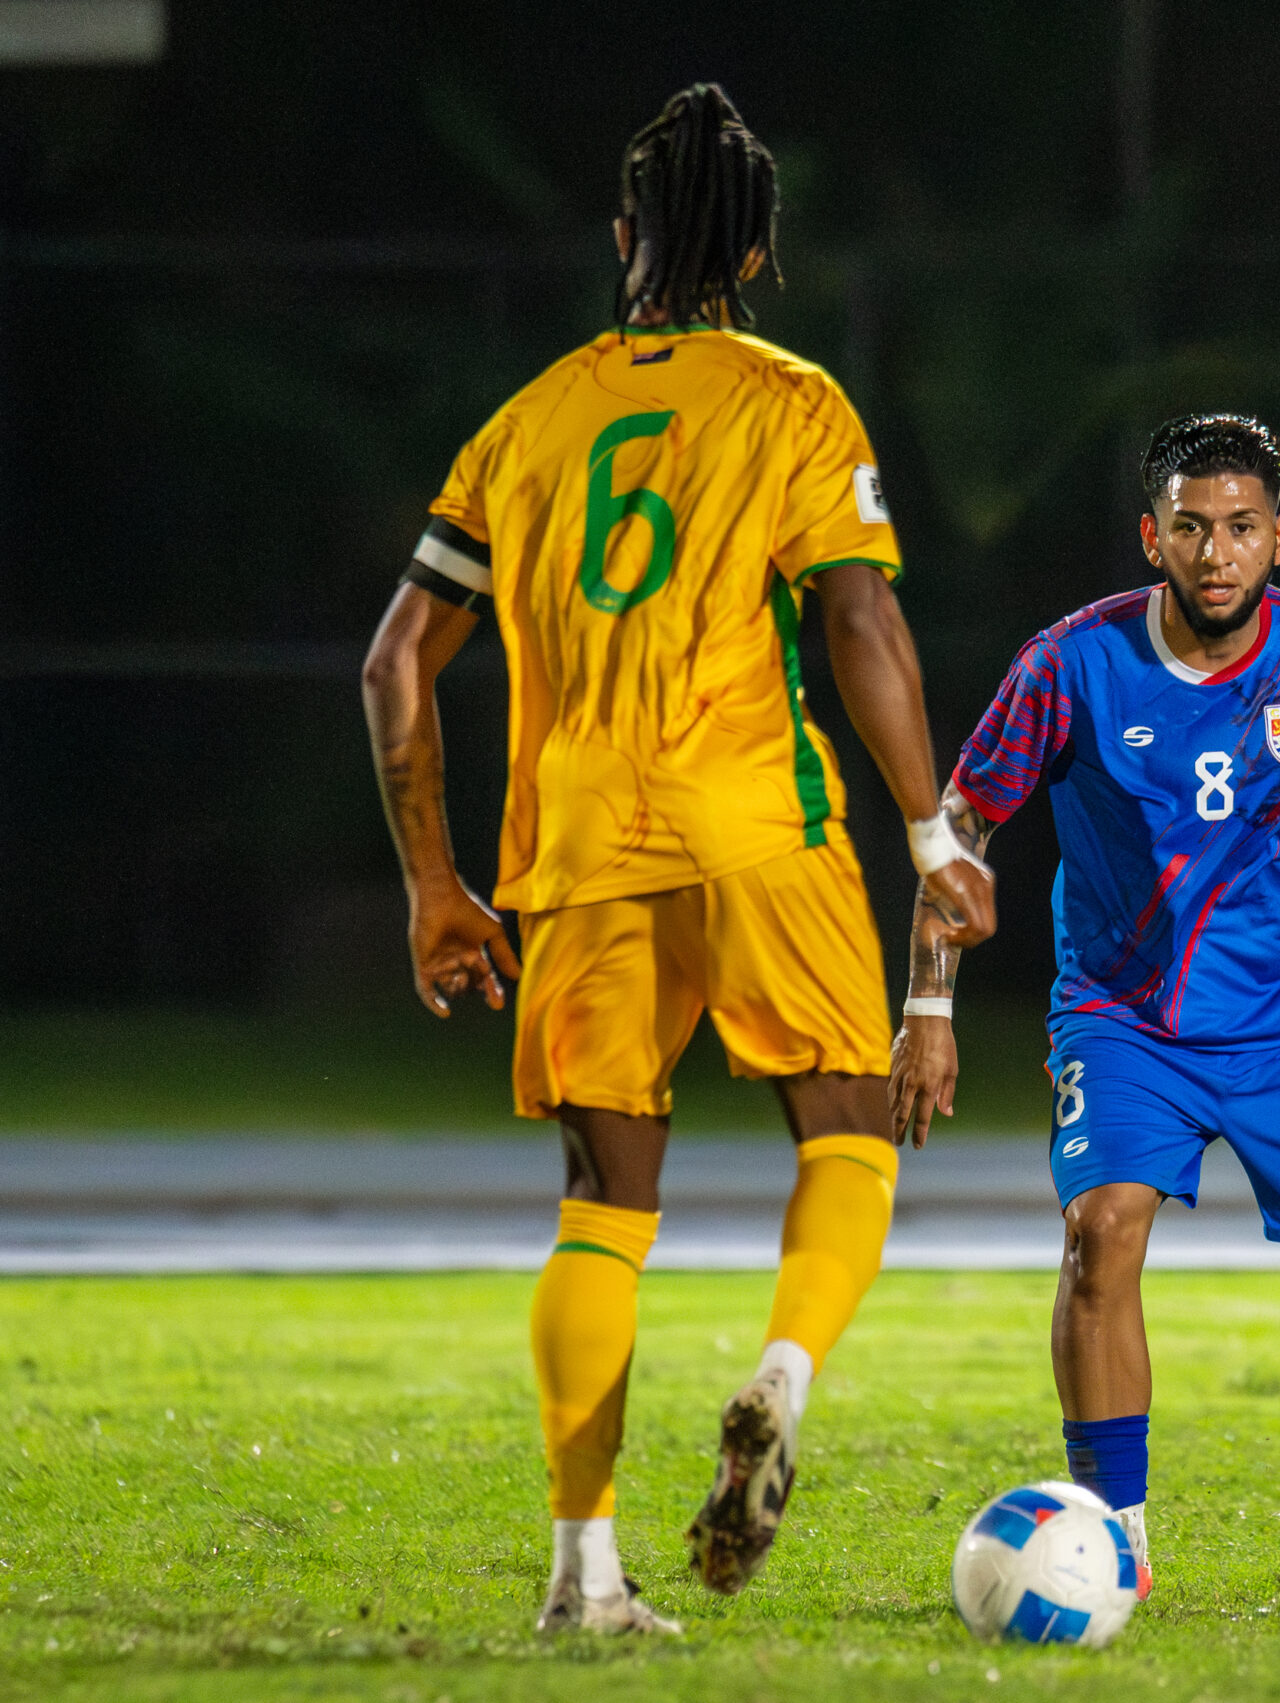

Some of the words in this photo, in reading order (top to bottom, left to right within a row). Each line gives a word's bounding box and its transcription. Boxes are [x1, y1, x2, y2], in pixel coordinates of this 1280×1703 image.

[580, 409, 676, 614] 6
[1195, 751, 1235, 821] 8
[1056, 1060, 1086, 1128] 8
